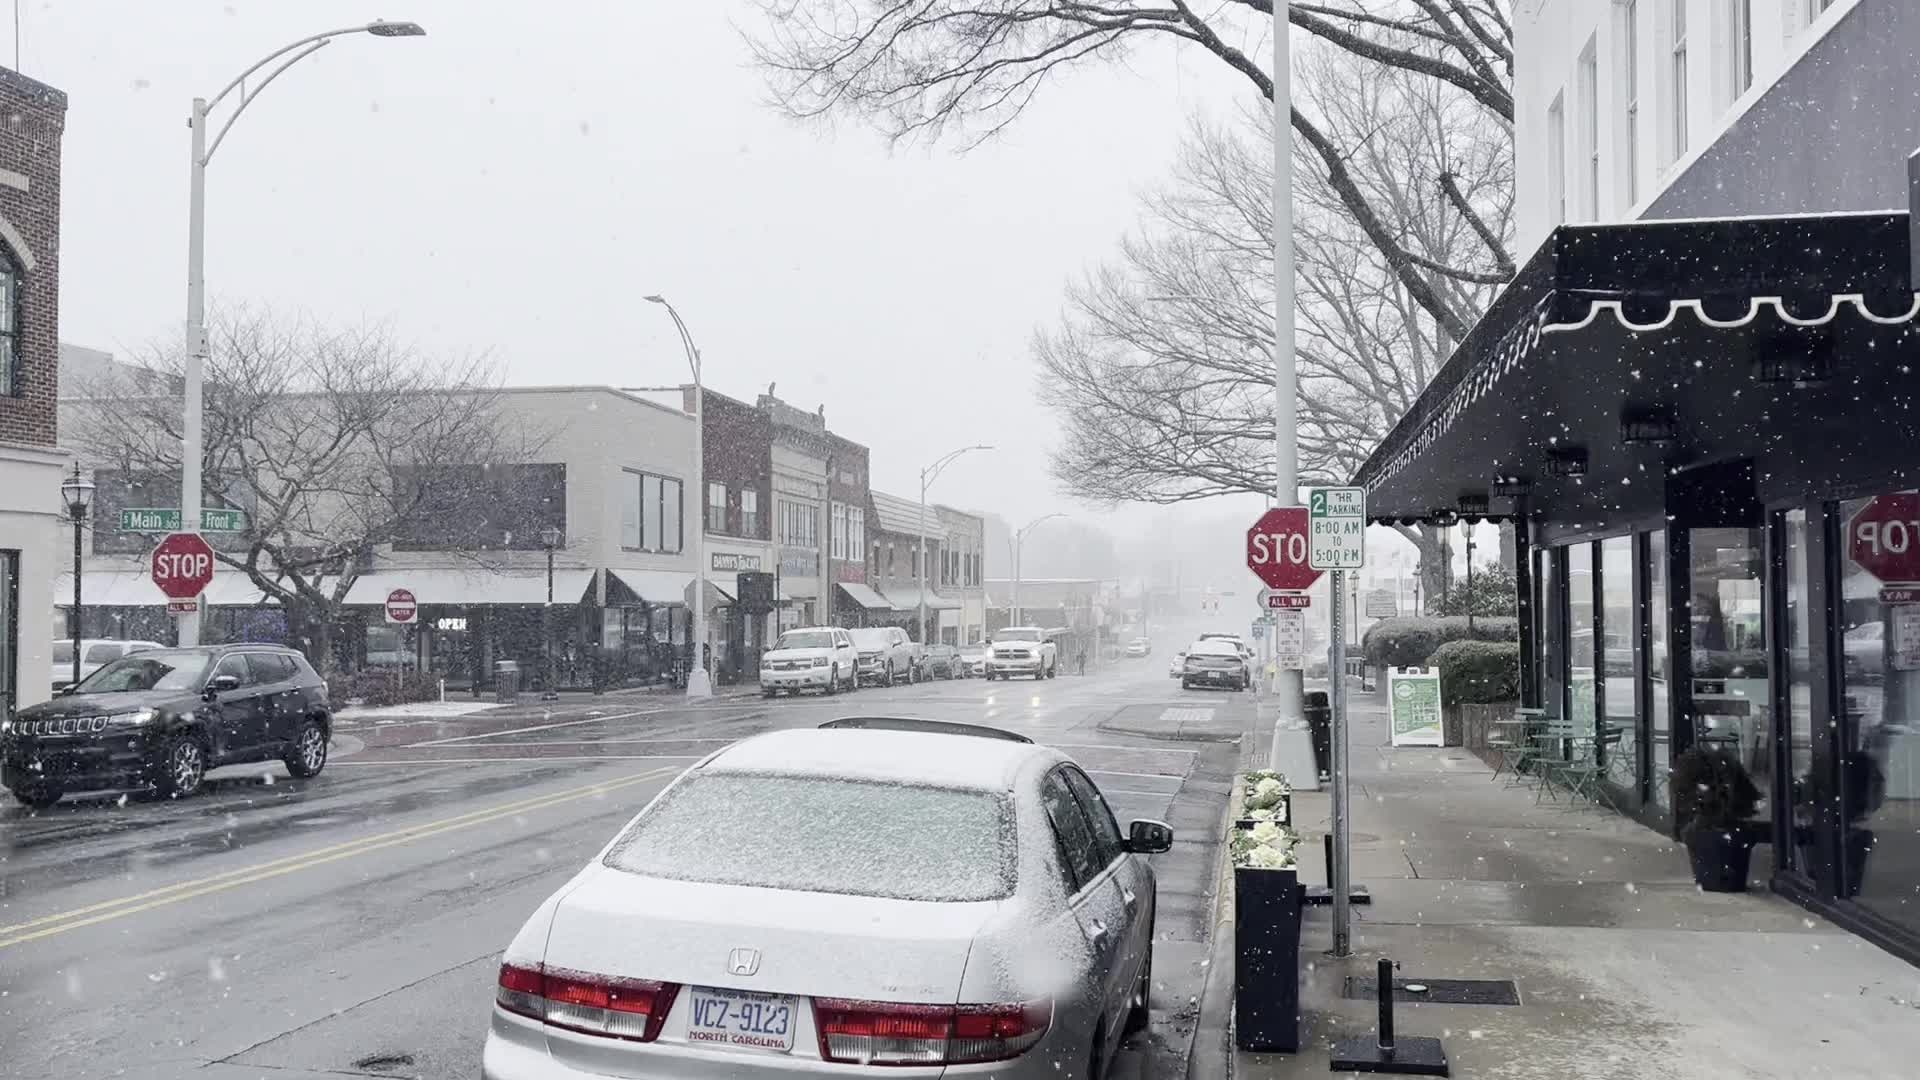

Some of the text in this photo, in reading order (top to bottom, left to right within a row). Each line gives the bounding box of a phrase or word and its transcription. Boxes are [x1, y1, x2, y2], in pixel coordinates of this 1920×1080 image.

[1312, 492, 1353, 514] 2 HR
[1328, 504, 1361, 514] PARKING
[131, 511, 162, 529] Main
[206, 511, 229, 529] Front
[1315, 521, 1359, 534] 8:00 AM
[1252, 533, 1307, 564] STO
[1332, 535, 1342, 547] TO
[1316, 548, 1359, 562] 5:00 PM
[156, 553, 208, 579] STOP
[169, 603, 196, 612] ALL WAY
[1271, 597, 1308, 606] ALL WAY
[438, 617, 467, 630] OPEN
[694, 998, 789, 1035] VCZ-9123
[689, 1031, 785, 1048] NORTH CAROLINA
